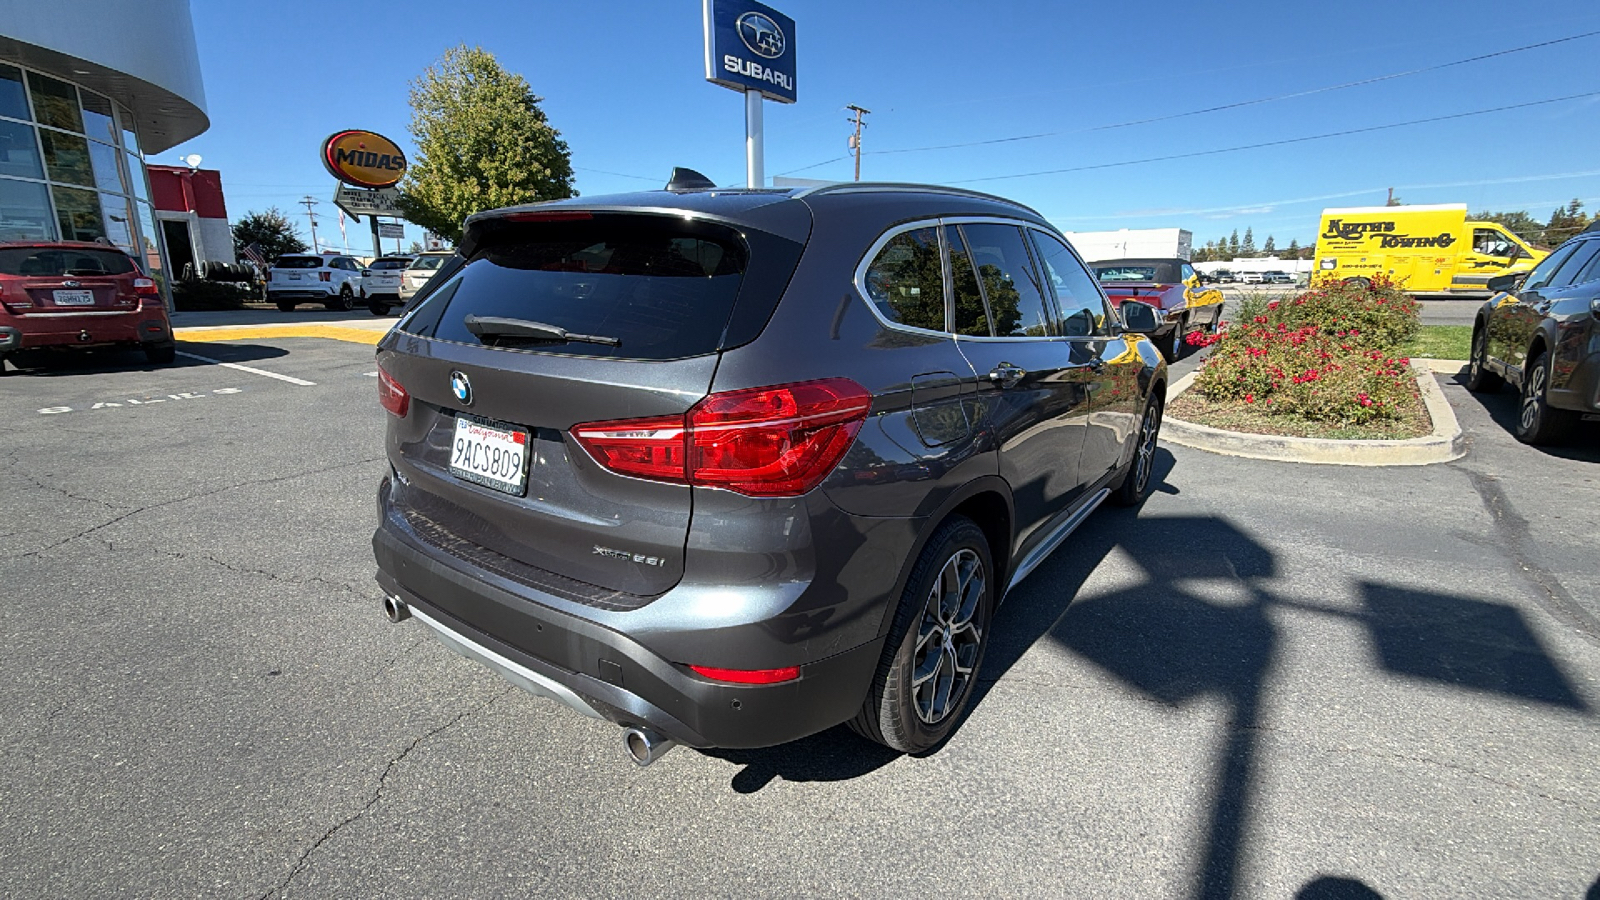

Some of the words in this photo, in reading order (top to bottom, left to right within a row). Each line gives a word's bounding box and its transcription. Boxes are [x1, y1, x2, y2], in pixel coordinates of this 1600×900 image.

[724, 54, 793, 91] SUBARU
[337, 147, 403, 170] MIDAS
[455, 438, 521, 480] 9ACS809
